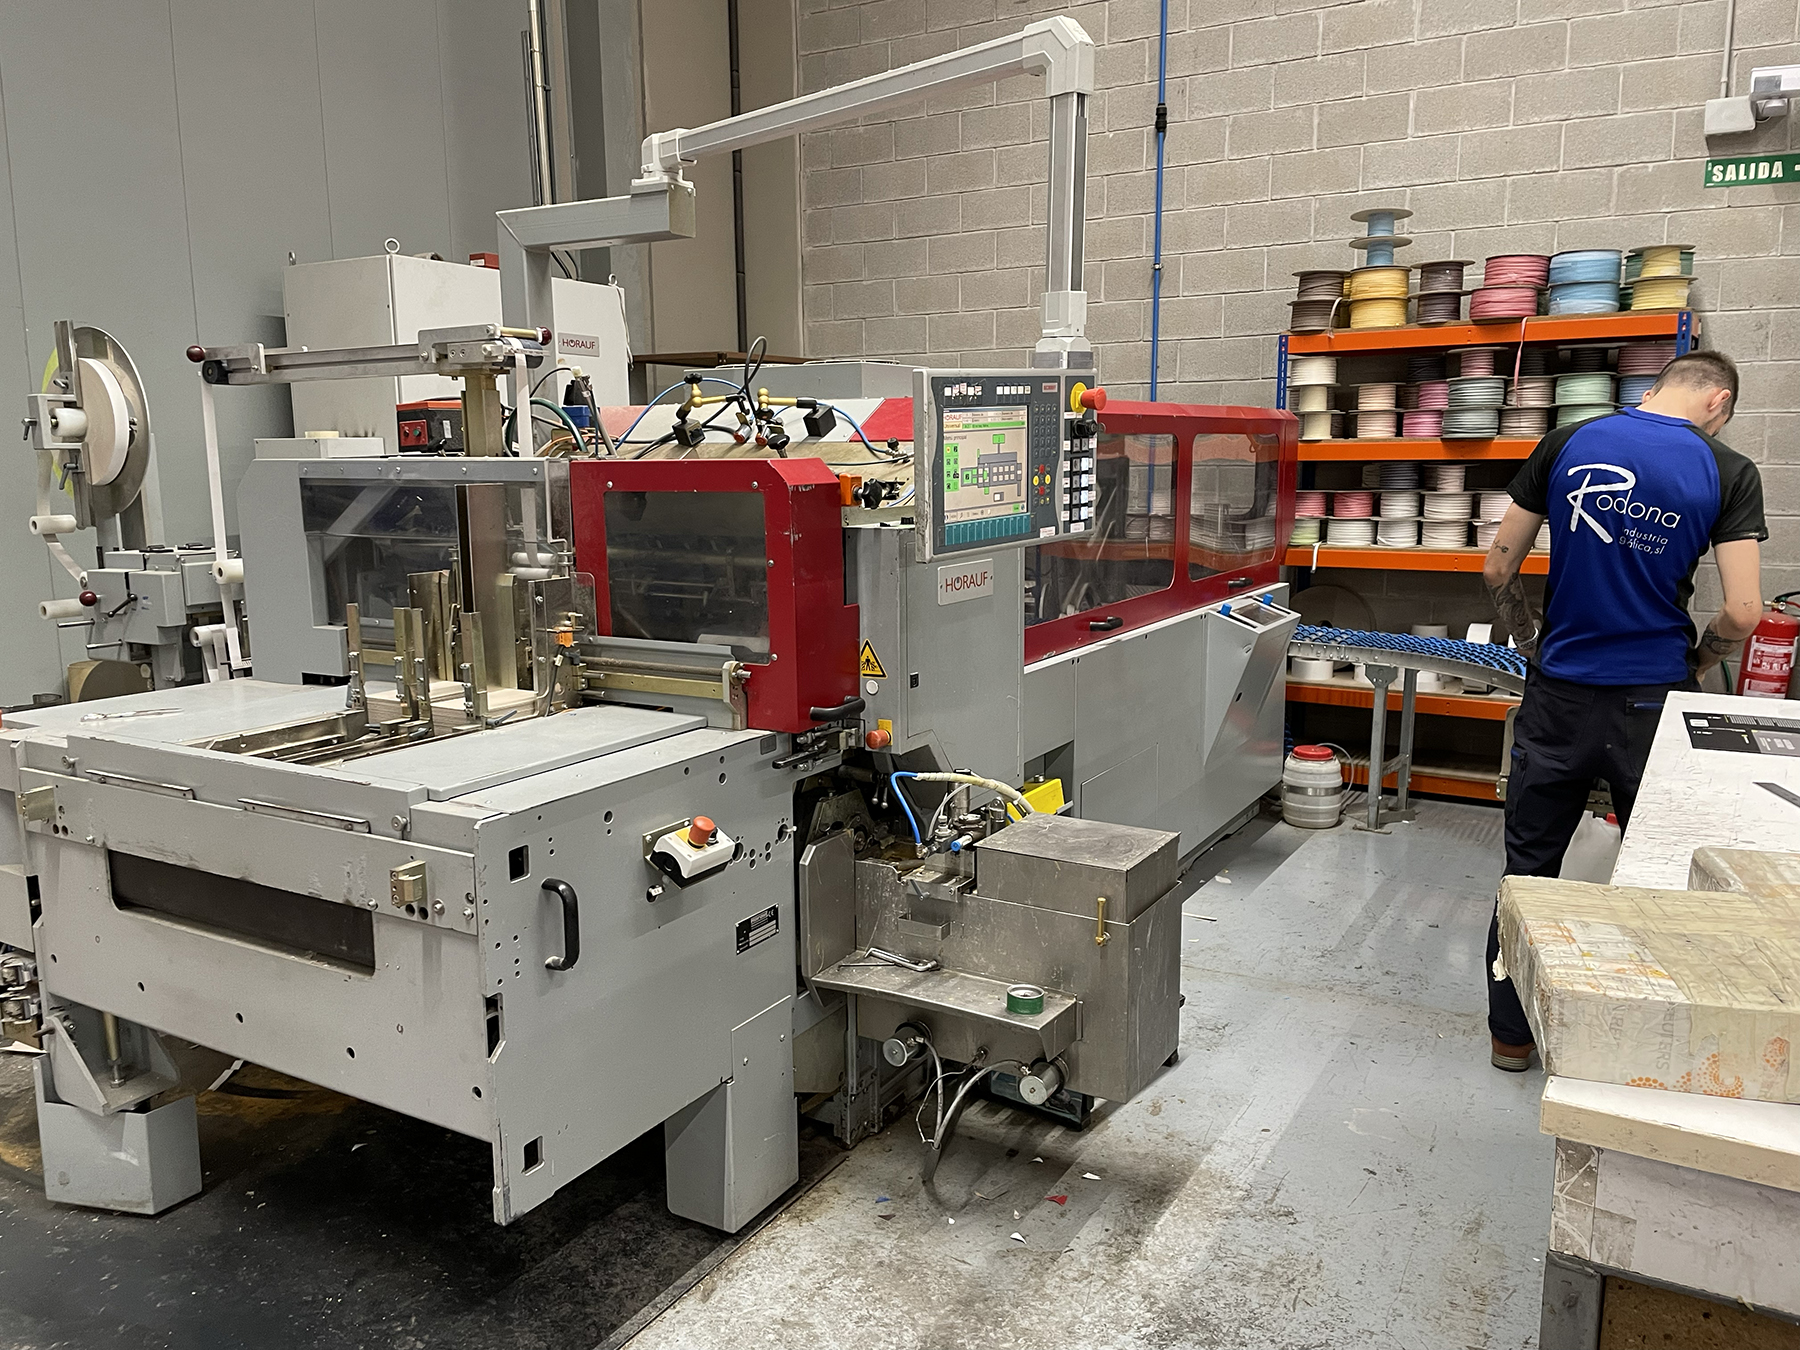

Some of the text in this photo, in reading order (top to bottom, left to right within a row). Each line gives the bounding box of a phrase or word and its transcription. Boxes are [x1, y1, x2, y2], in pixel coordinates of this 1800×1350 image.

[1712, 161, 1783, 182] SALIDA
[1566, 463, 1682, 544] Rodona
[1621, 525, 1669, 545] ndustria
